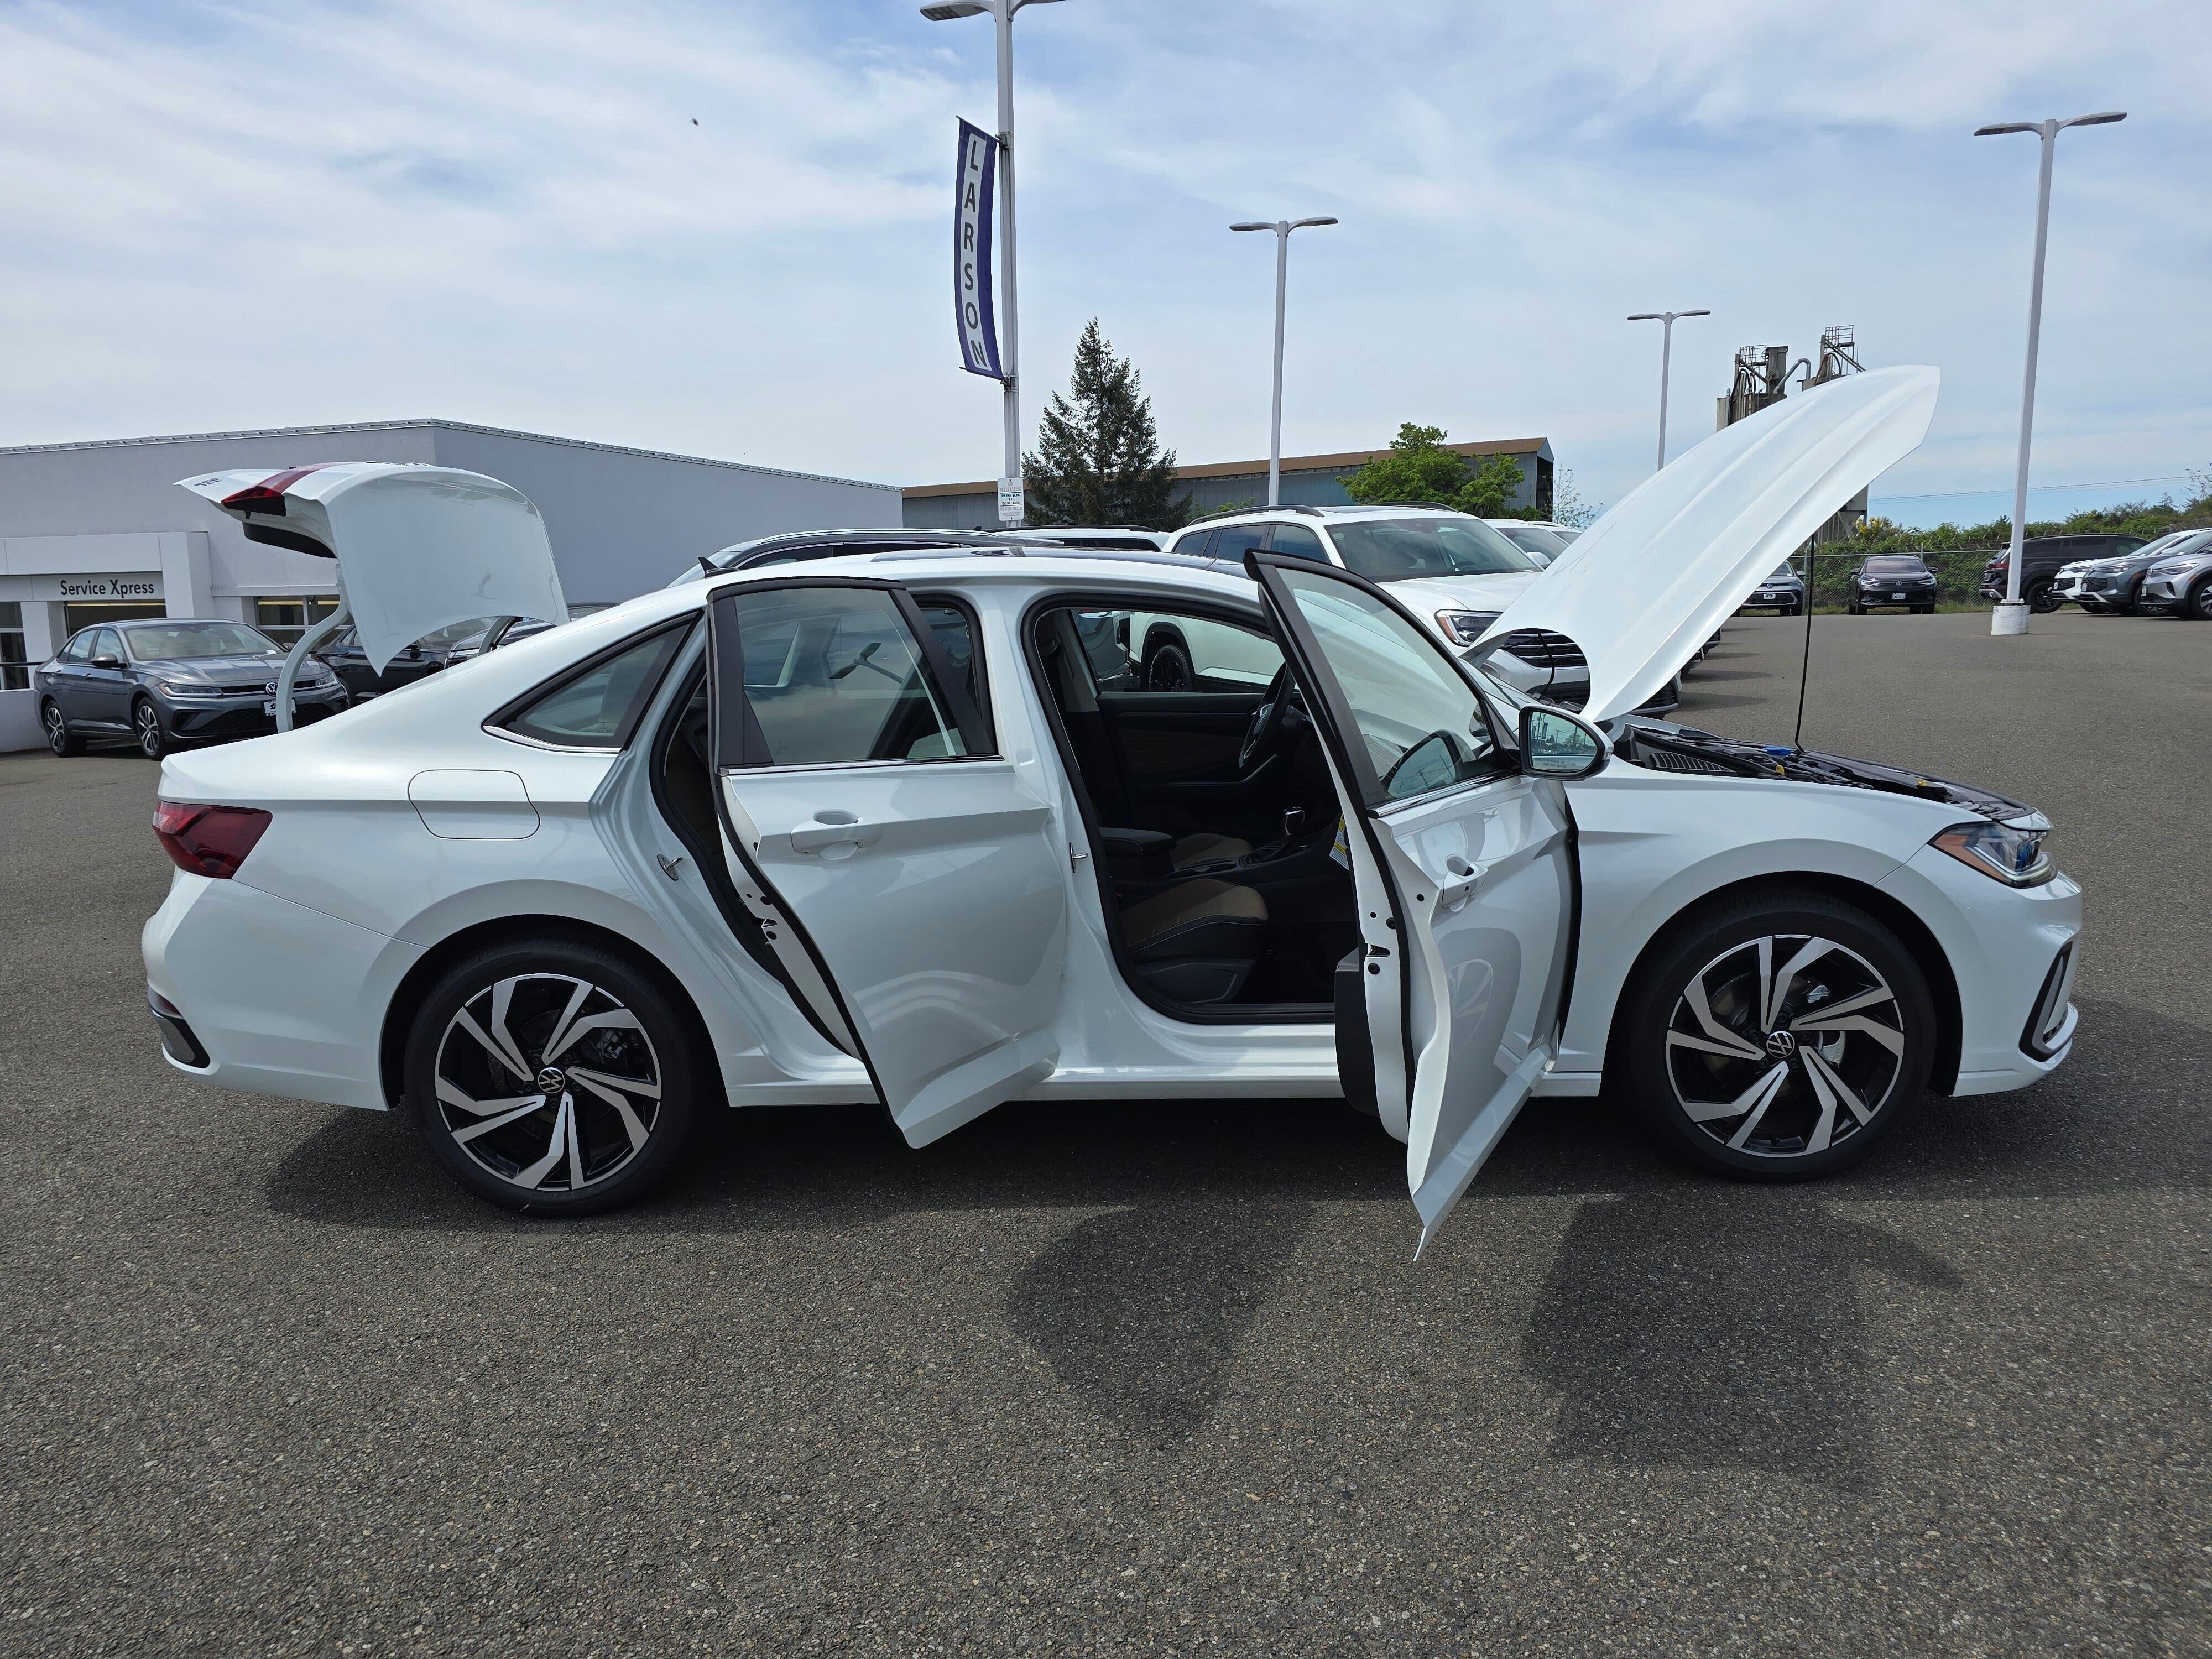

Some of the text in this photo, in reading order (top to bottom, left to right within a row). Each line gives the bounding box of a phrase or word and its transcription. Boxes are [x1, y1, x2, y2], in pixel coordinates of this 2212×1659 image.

[964, 139, 988, 367] LARSON
[60, 578, 154, 598] Service Xpress
